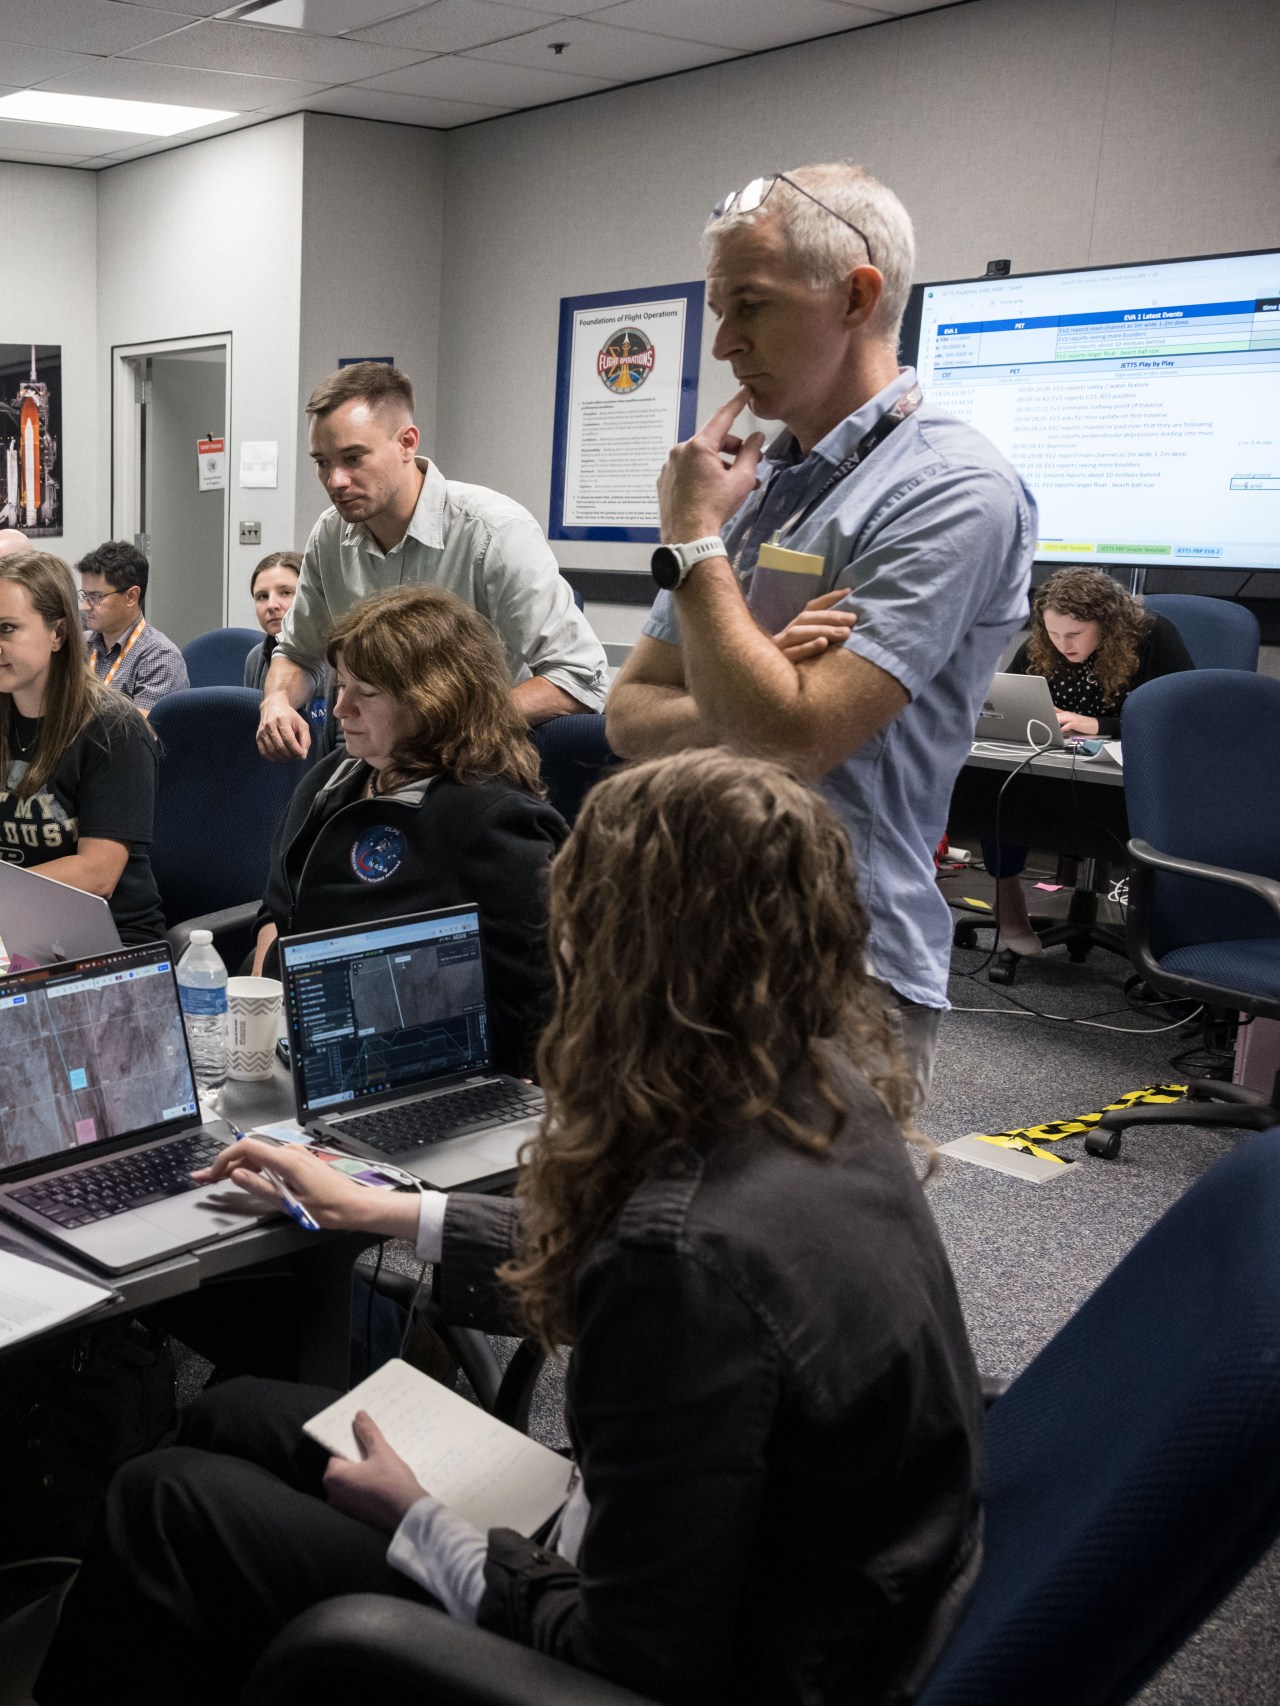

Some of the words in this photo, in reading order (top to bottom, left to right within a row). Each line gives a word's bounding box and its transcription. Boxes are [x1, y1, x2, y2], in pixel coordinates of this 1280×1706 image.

[580, 317, 616, 326] Foundations
[625, 314, 642, 322] Flight
[644, 310, 678, 320] Operations
[1143, 312, 1161, 320] Latest
[1162, 311, 1183, 319] Events
[599, 355, 619, 370] FLIGHT
[620, 351, 652, 366] OPERATIONS
[1087, 351, 1102, 359] larger
[14, 793, 54, 820] MY
[385, 826, 400, 836] CLPS
[369, 861, 388, 873] NASA
